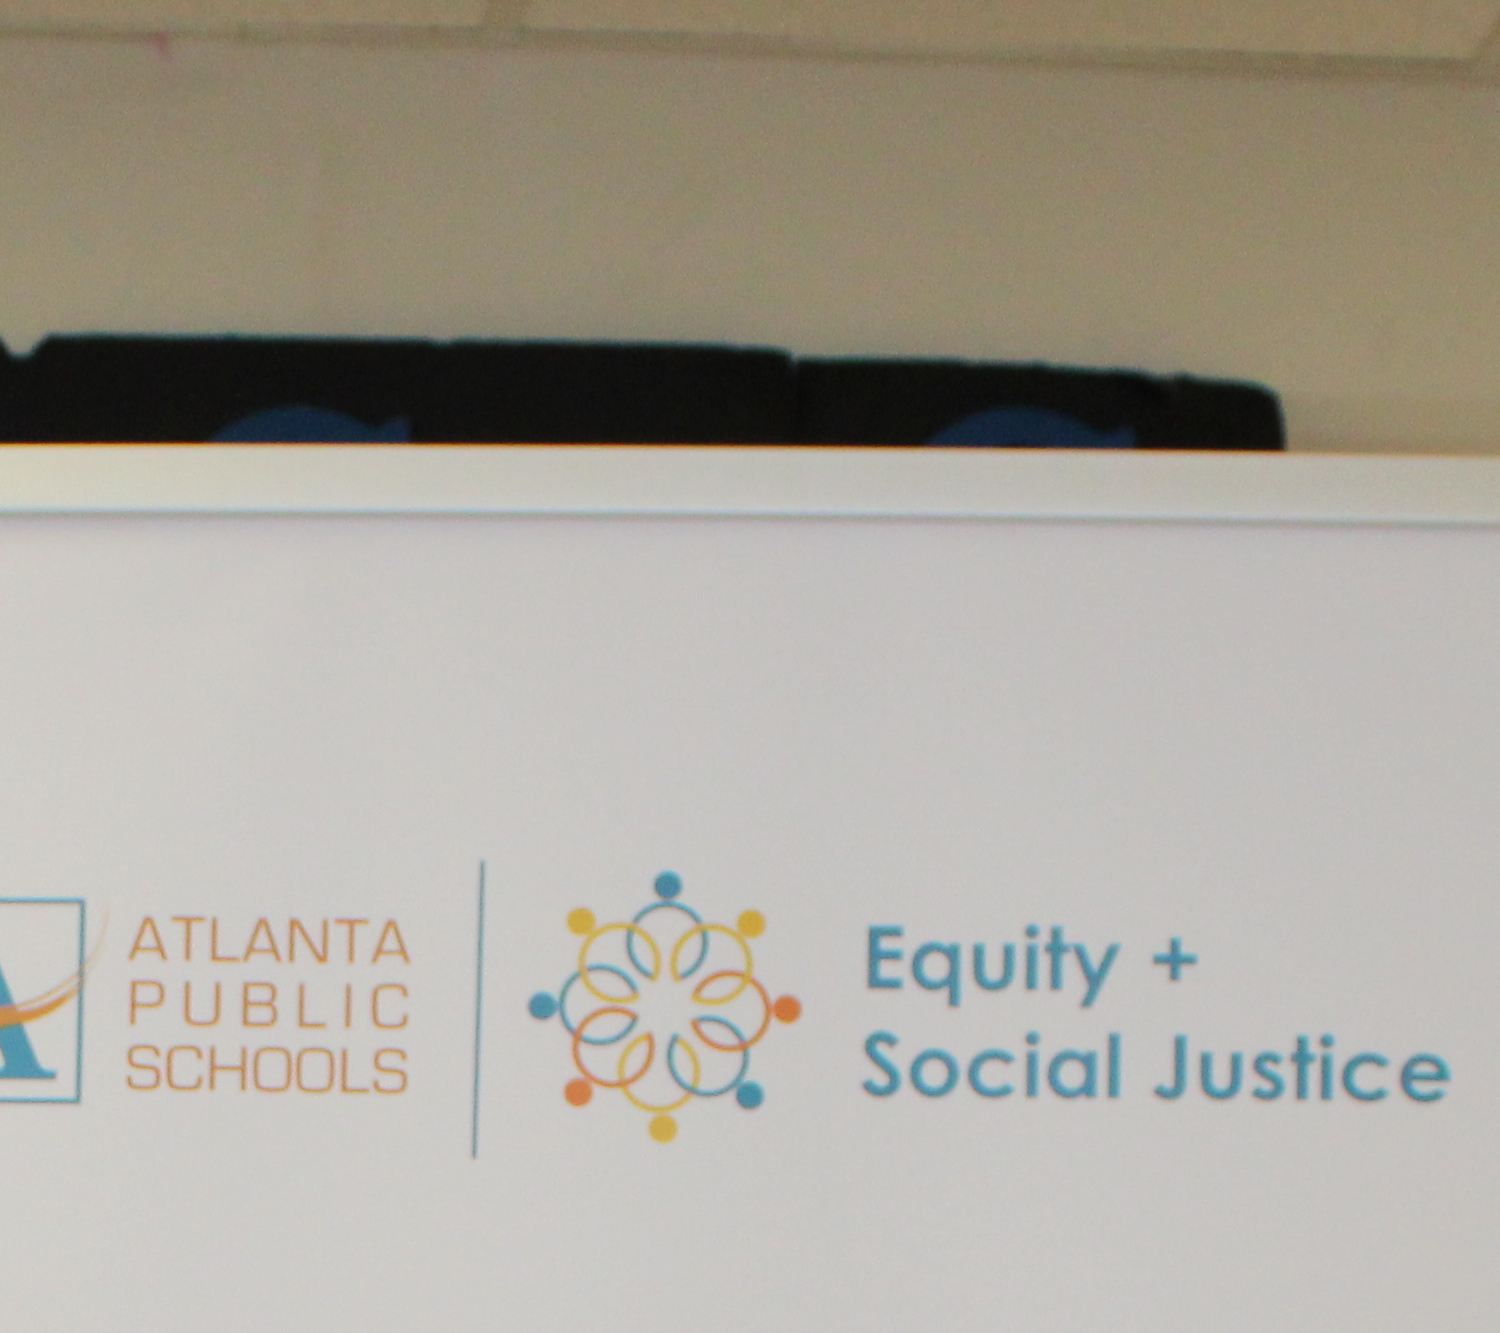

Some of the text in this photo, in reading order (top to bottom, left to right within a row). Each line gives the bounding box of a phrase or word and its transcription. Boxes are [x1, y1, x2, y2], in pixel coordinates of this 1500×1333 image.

[126, 916, 412, 966] ATLANTA
[868, 923, 1122, 1007] Equity
[127, 980, 411, 1030] PUBLIC
[125, 1044, 411, 1096] SCHOOLS
[864, 1029, 1453, 1101] Social Justice
